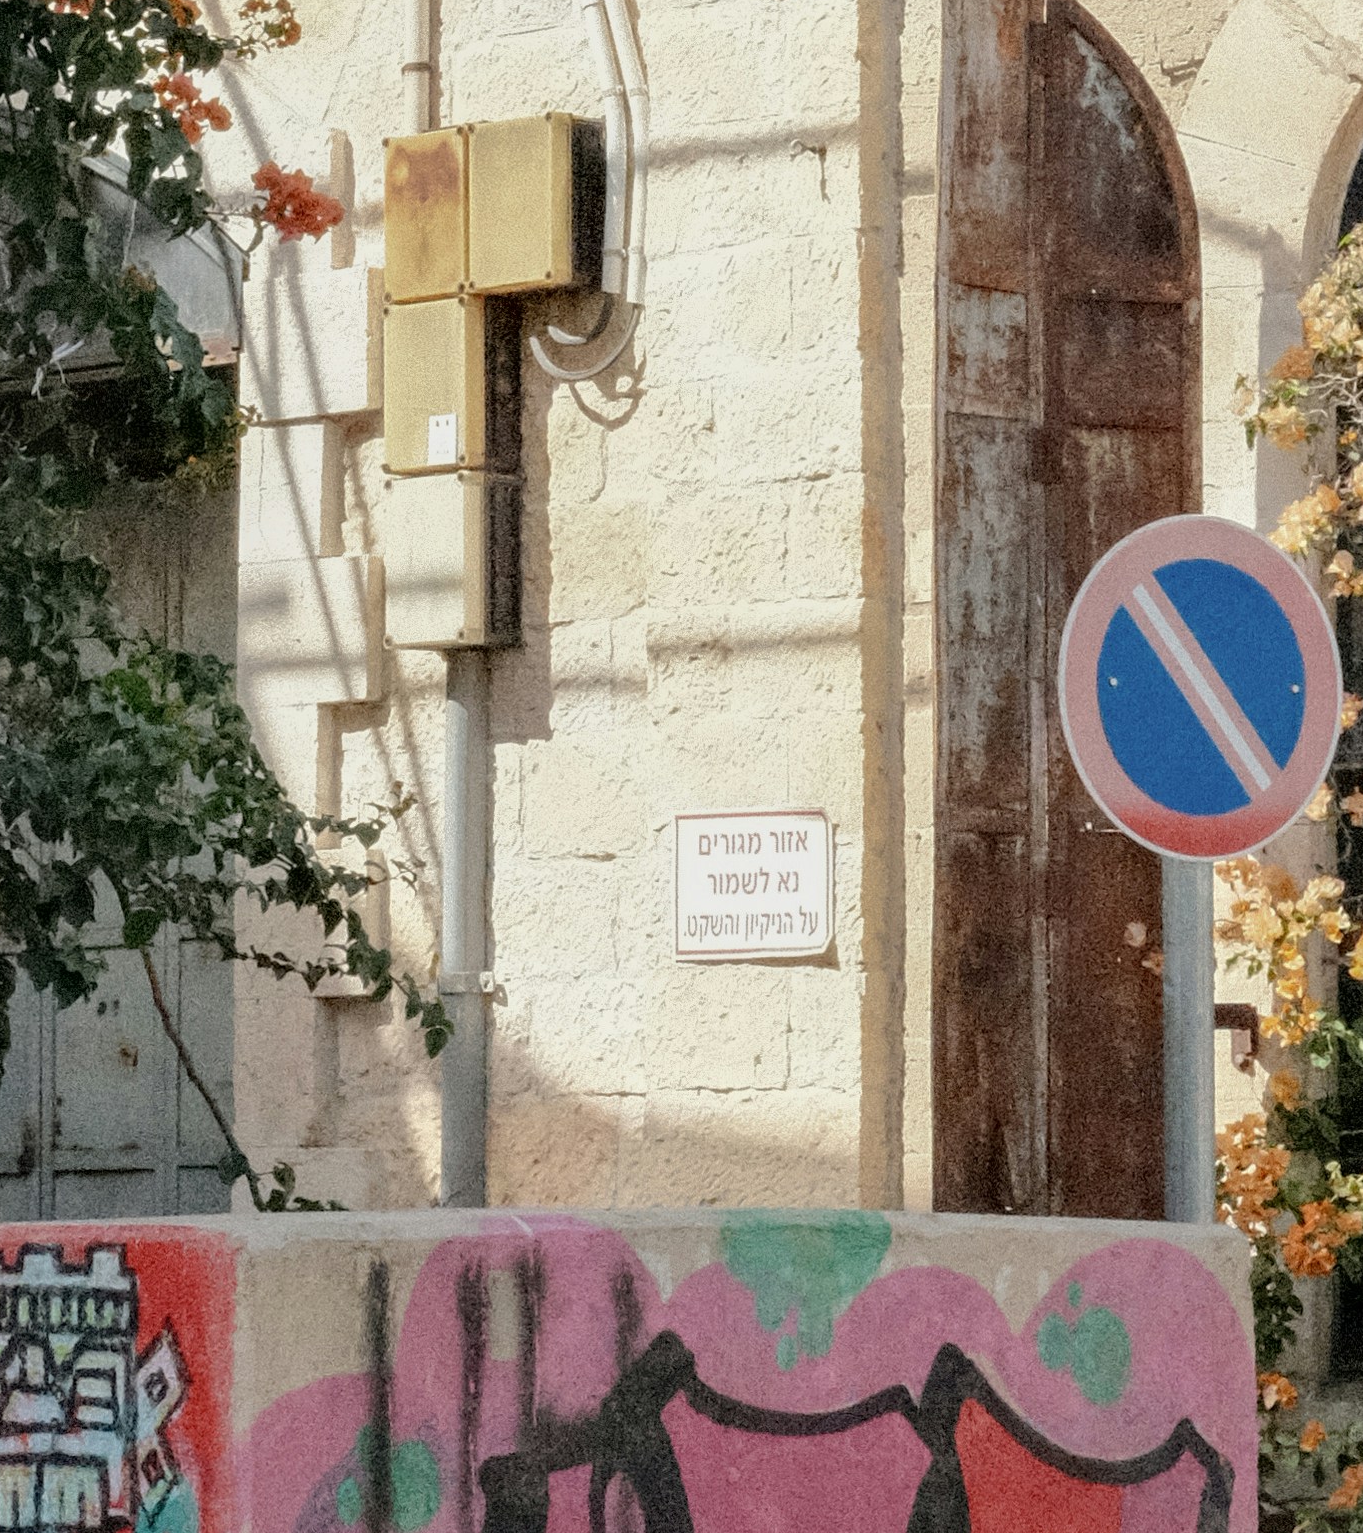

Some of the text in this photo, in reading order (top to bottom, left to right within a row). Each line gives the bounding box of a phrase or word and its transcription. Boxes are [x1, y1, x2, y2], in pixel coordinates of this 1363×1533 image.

[698, 830, 808, 856] אזור מגורים
[707, 866, 800, 895] נא לשמור
[683, 905, 819, 943] על הניקיון והשקט.
